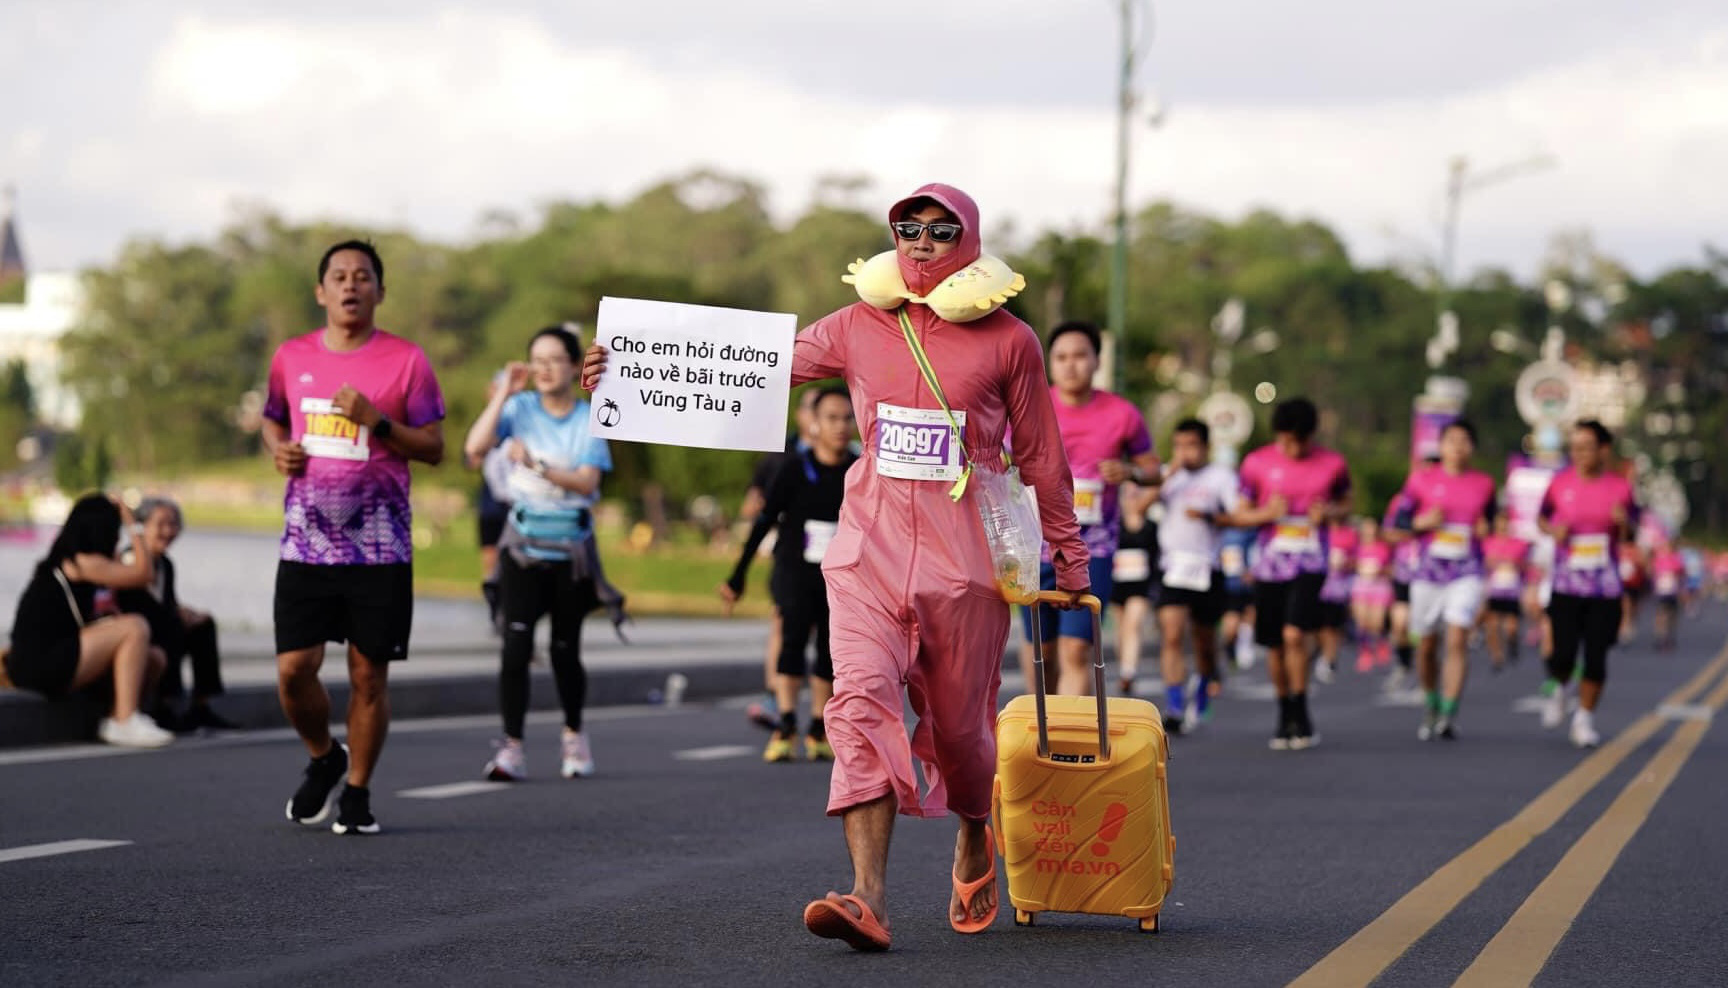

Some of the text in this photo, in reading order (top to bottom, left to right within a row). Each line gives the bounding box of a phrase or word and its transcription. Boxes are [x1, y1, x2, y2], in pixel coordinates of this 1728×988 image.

[611, 336, 779, 367] Cho em hỏi đường
[620, 362, 766, 389] nào về bãi trước
[640, 389, 742, 416] Vũng Tàu ạ
[880, 422, 947, 455] 20697
[1032, 820, 1072, 835] vali
[1036, 858, 1121, 876] mia.vn
